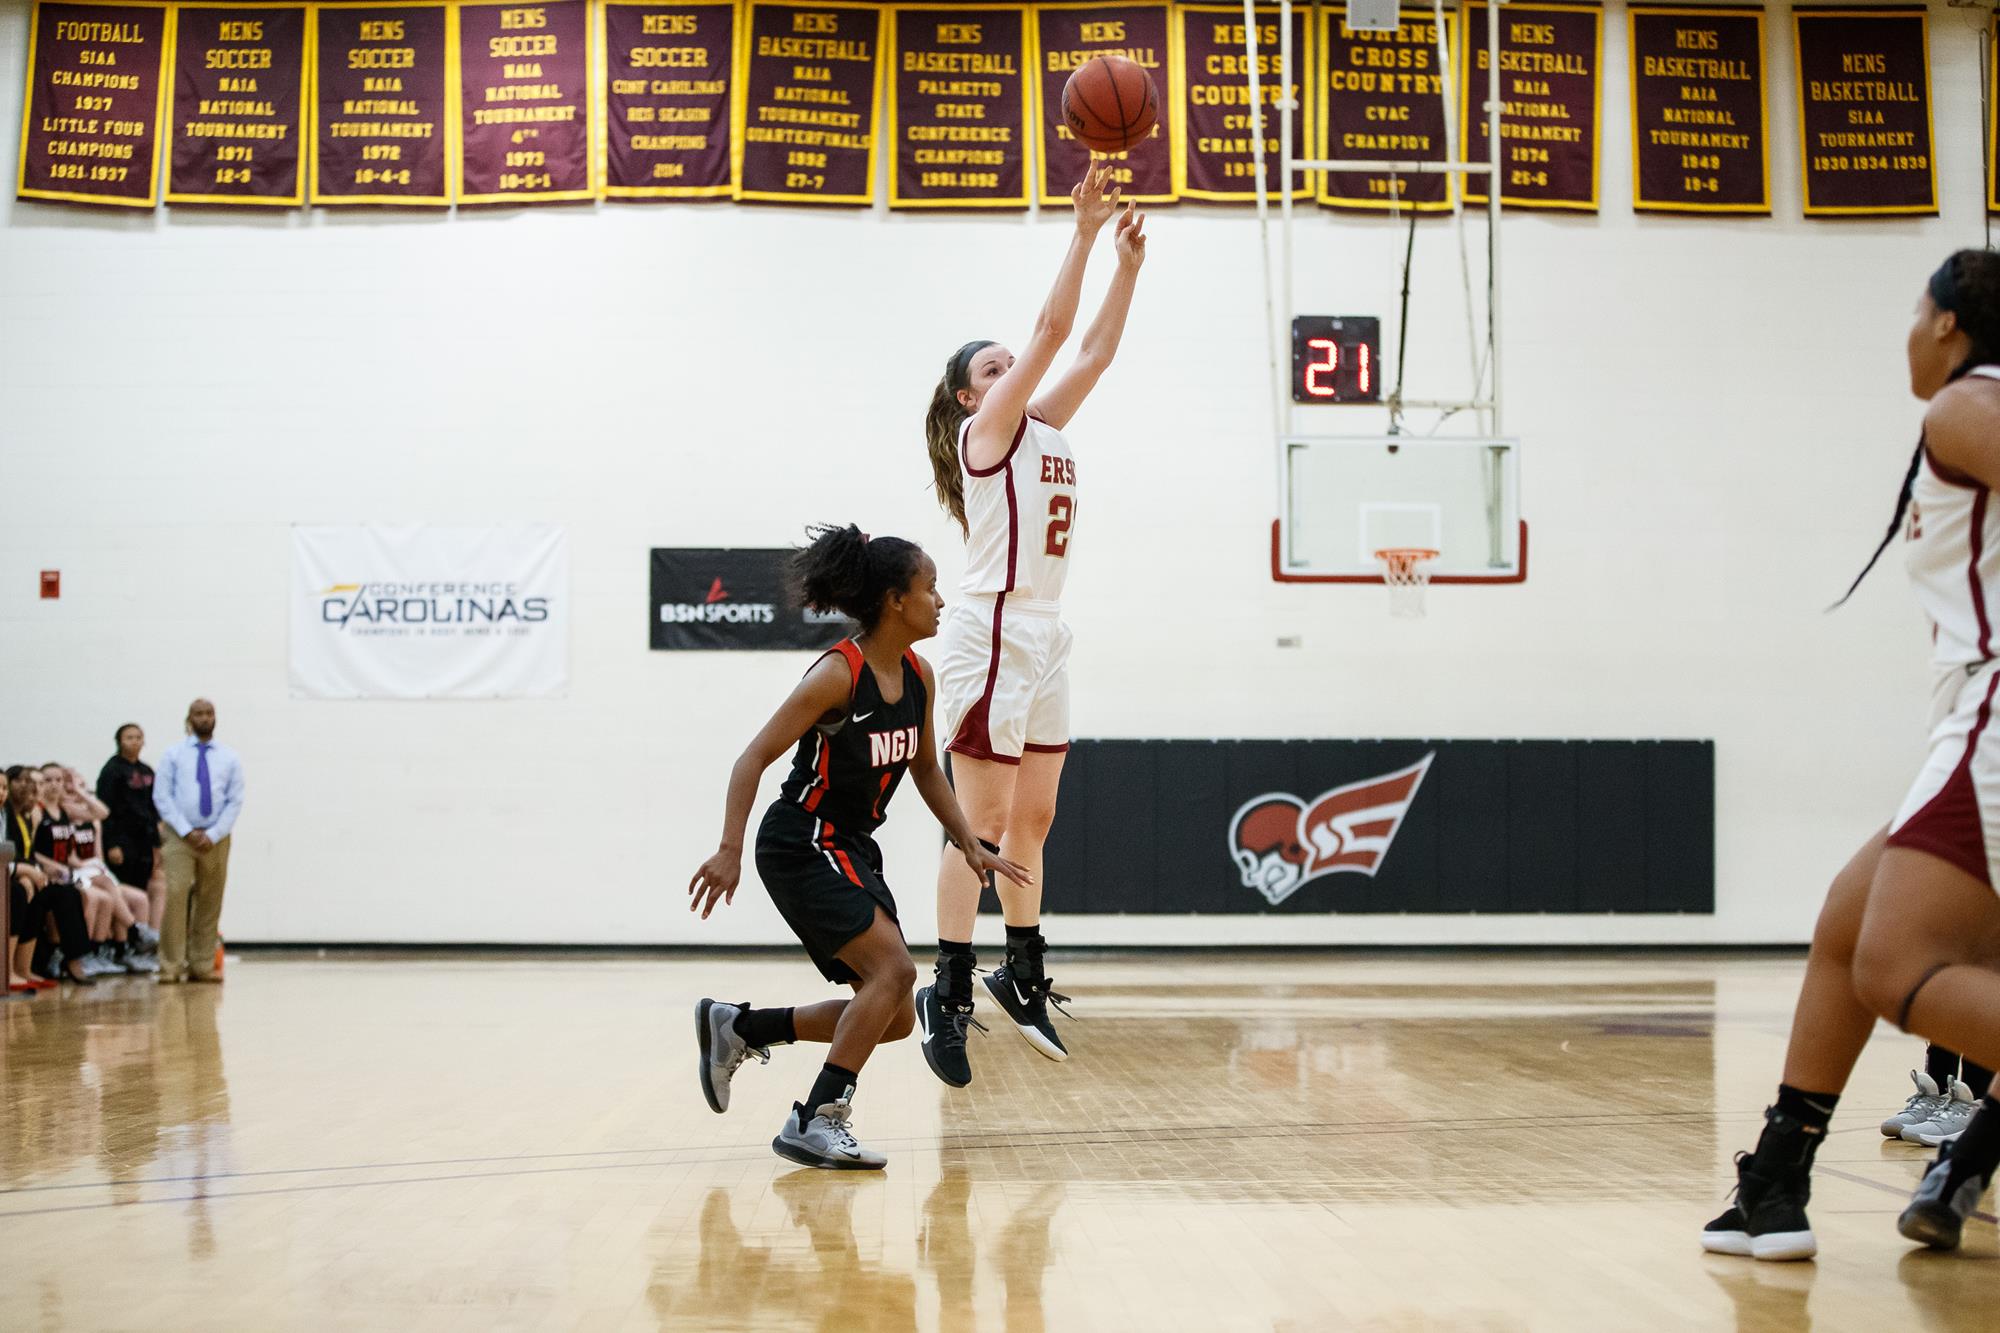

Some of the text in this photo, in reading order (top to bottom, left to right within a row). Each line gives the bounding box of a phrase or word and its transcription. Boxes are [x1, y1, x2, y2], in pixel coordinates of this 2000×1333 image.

[500, 8, 546, 29] MENS
[642, 15, 697, 34] MENS
[793, 13, 838, 33] MENS
[56, 22, 144, 43] FOOTBALL
[219, 21, 264, 41] MENS
[359, 20, 405, 40] MENS
[936, 24, 982, 43] MENS
[1080, 21, 1126, 42] MENS
[1510, 24, 1555, 45] MENS
[1676, 29, 1719, 49] MENS
[489, 35, 558, 57] SOCCER
[758, 36, 871, 61] BASKETBALL
[80, 50, 116, 65] SIAA
[205, 49, 272, 69] SOCCER
[347, 48, 415, 69] SOCCER
[630, 47, 708, 67] SOCCER
[903, 51, 1016, 75] BASKETBALL
[1047, 48, 1160, 72] BASALL
[1206, 54, 1284, 75] CROSS
[1350, 46, 1429, 69] CROSS
[1477, 49, 1588, 75] BSKETBALL
[1842, 54, 1886, 74] MENS
[503, 63, 542, 78] NAIA
[793, 66, 831, 81] NAIA
[1644, 56, 1751, 81] BASKETBALL
[52, 71, 140, 90] CHAMPIONS
[218, 77, 257, 92] NAIA
[363, 77, 402, 92] NAIA
[918, 80, 1002, 97] PALMETTO
[1331, 70, 1442, 95] COUNTRY
[1513, 80, 1551, 96] NAIA
[485, 84, 563, 101] NATIONAL
[774, 87, 850, 105] NATIONAL
[1680, 86, 1718, 101] NAIA
[1810, 81, 1919, 102] BASKETBALL
[75, 96, 113, 111] 1937
[199, 99, 276, 116] NATIONAL
[343, 100, 420, 115] NATIONAL
[935, 104, 985, 118] STATE
[1501, 101, 1570, 119] ATIONAL
[474, 106, 576, 124] TOURNAMENT
[758, 106, 861, 128] TOURNAMENT
[1365, 106, 1410, 121] CVAC
[1663, 108, 1735, 125] NATIONAL
[1848, 110, 1885, 125] SIAA
[42, 117, 145, 136] LITTLE FOUR
[185, 122, 288, 139] TOURNAMENT
[330, 122, 434, 138] TOURNAMENT
[907, 126, 1011, 142] CONFERENCE
[1480, 122, 1582, 142] TURNAMENT
[1649, 129, 1750, 149] TOURNAMENT
[1818, 132, 1915, 148] TOURNAMENT
[47, 141, 134, 159] CHAMPIONS
[216, 146, 253, 161] 1971
[362, 145, 401, 160] 1972
[914, 150, 1004, 165] CHAMPIONS
[1511, 147, 1549, 163] 1974
[1224, 162, 1268, 178] 199
[1682, 154, 1720, 169] 1949
[1813, 156, 1927, 171] 1930 1934 1939
[50, 164, 128, 181] 1921 1937
[1306, 339, 1368, 395] 21
[1040, 455, 1076, 487] ERS
[1044, 494, 1077, 559] 2
[369, 582, 517, 597] CONFERENCE
[322, 593, 549, 625] CAROLINAS
[868, 726, 918, 768] NGU
